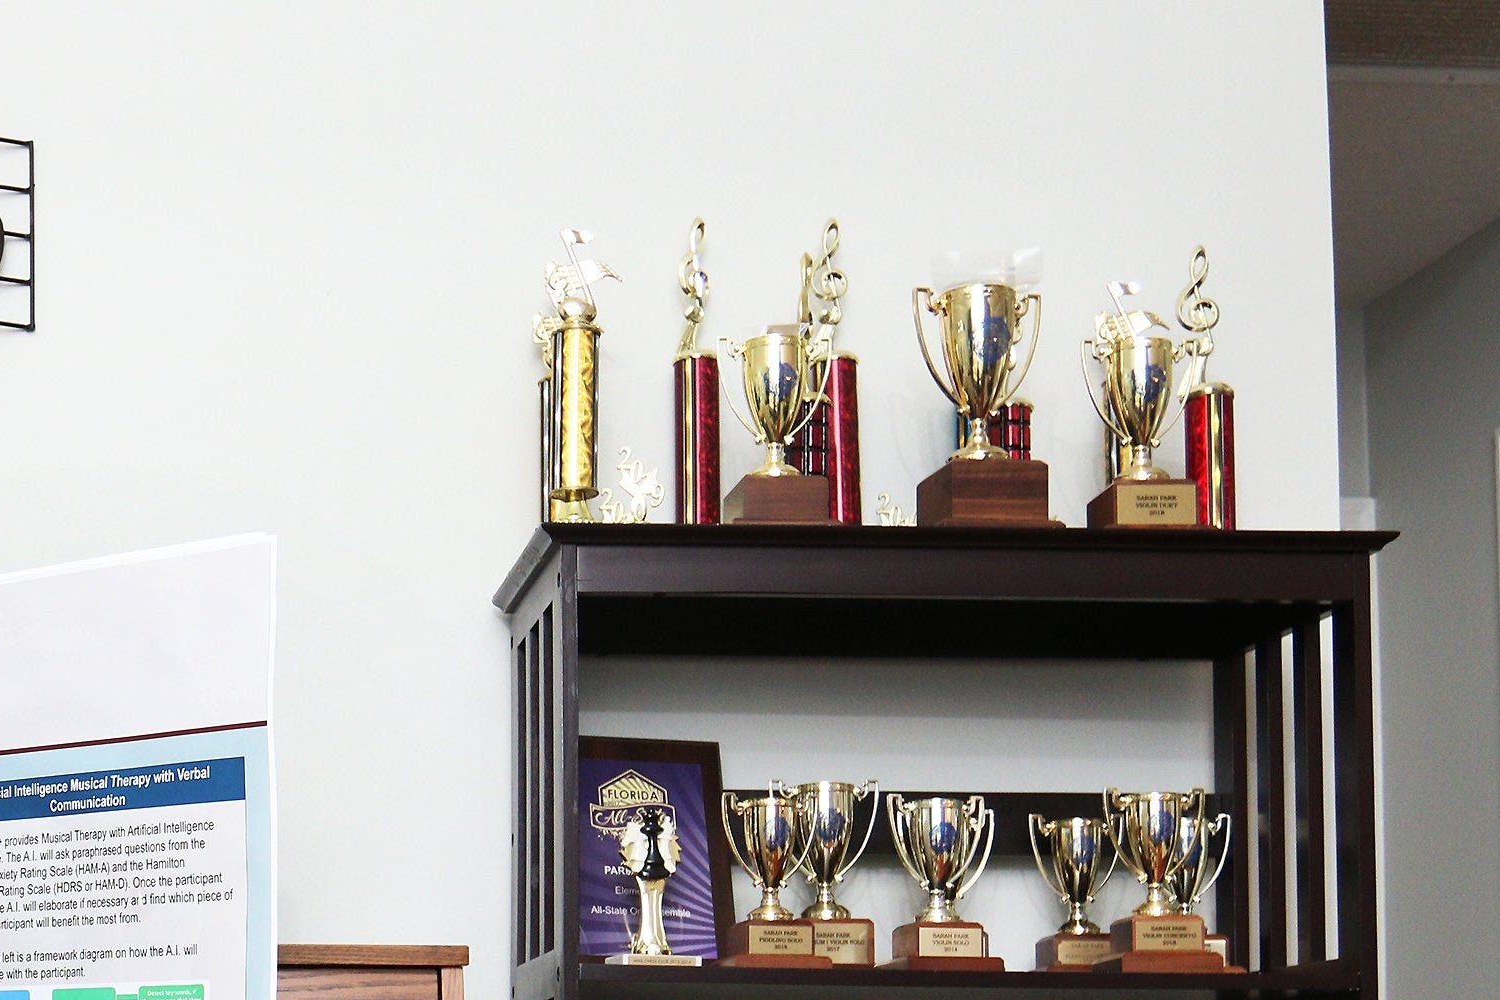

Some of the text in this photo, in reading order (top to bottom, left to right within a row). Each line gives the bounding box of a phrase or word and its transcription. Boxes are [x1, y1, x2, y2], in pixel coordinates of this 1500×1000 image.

[14, 782, 67, 797] Intelligence
[70, 776, 107, 791] Musical
[110, 774, 150, 788] Therapy
[153, 769, 174, 783] with
[177, 765, 209, 780] Verbal
[50, 794, 125, 812] Communication
[608, 790, 658, 800] FLORIDA
[5, 834, 38, 849] provides
[41, 831, 72, 843] Musical
[74, 829, 106, 841] Therapy
[109, 826, 125, 837] with
[127, 823, 160, 836] Artificial
[164, 821, 214, 834] Intelligence
[591, 906, 627, 916] All-State
